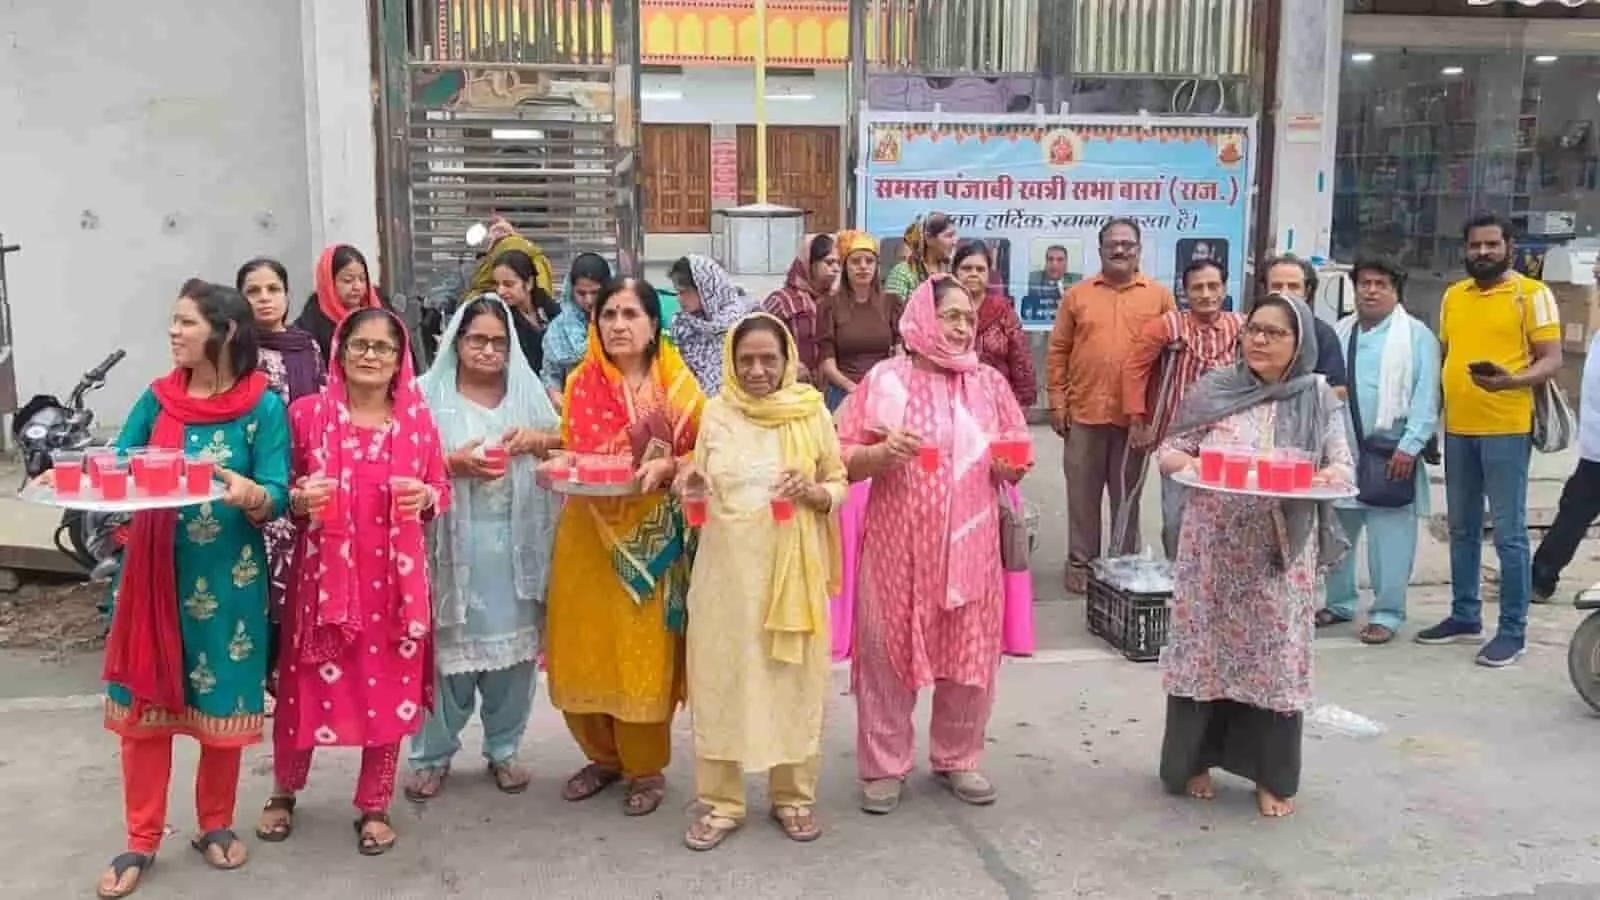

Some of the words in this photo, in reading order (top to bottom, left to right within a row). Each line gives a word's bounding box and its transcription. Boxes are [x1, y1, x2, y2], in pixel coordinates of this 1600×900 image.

[874, 178, 938, 200] समस्त
[943, 173, 1013, 200] पंजाबी
[1018, 174, 1067, 201] खत्री
[1071, 180, 1115, 201] सभा
[1118, 174, 1165, 201] बारां
[1169, 175, 1239, 208] (राज.)
[984, 209, 1044, 231] हार्दिक
